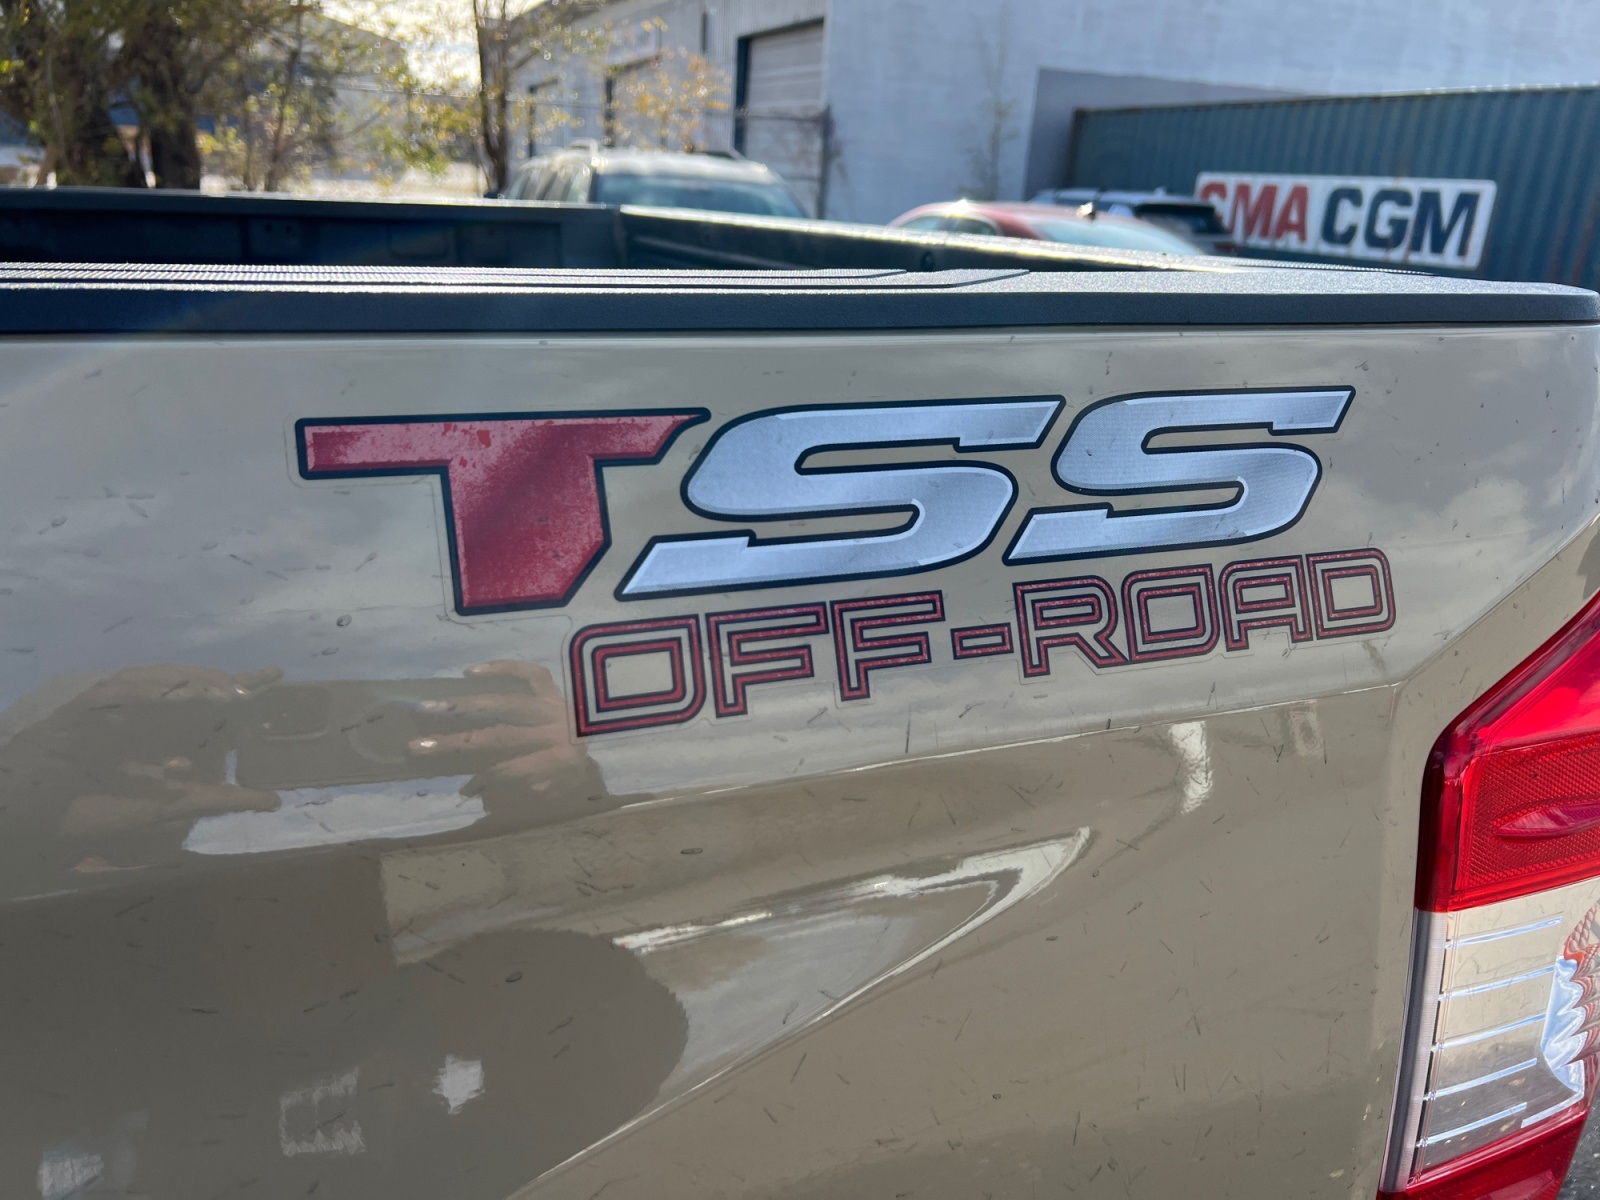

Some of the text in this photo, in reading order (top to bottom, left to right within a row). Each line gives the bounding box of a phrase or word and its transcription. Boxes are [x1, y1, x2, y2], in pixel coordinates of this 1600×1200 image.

[1321, 186, 1481, 257] CGM
[295, 386, 1356, 616] TSS
[569, 548, 1396, 737] OFF-ROAD
